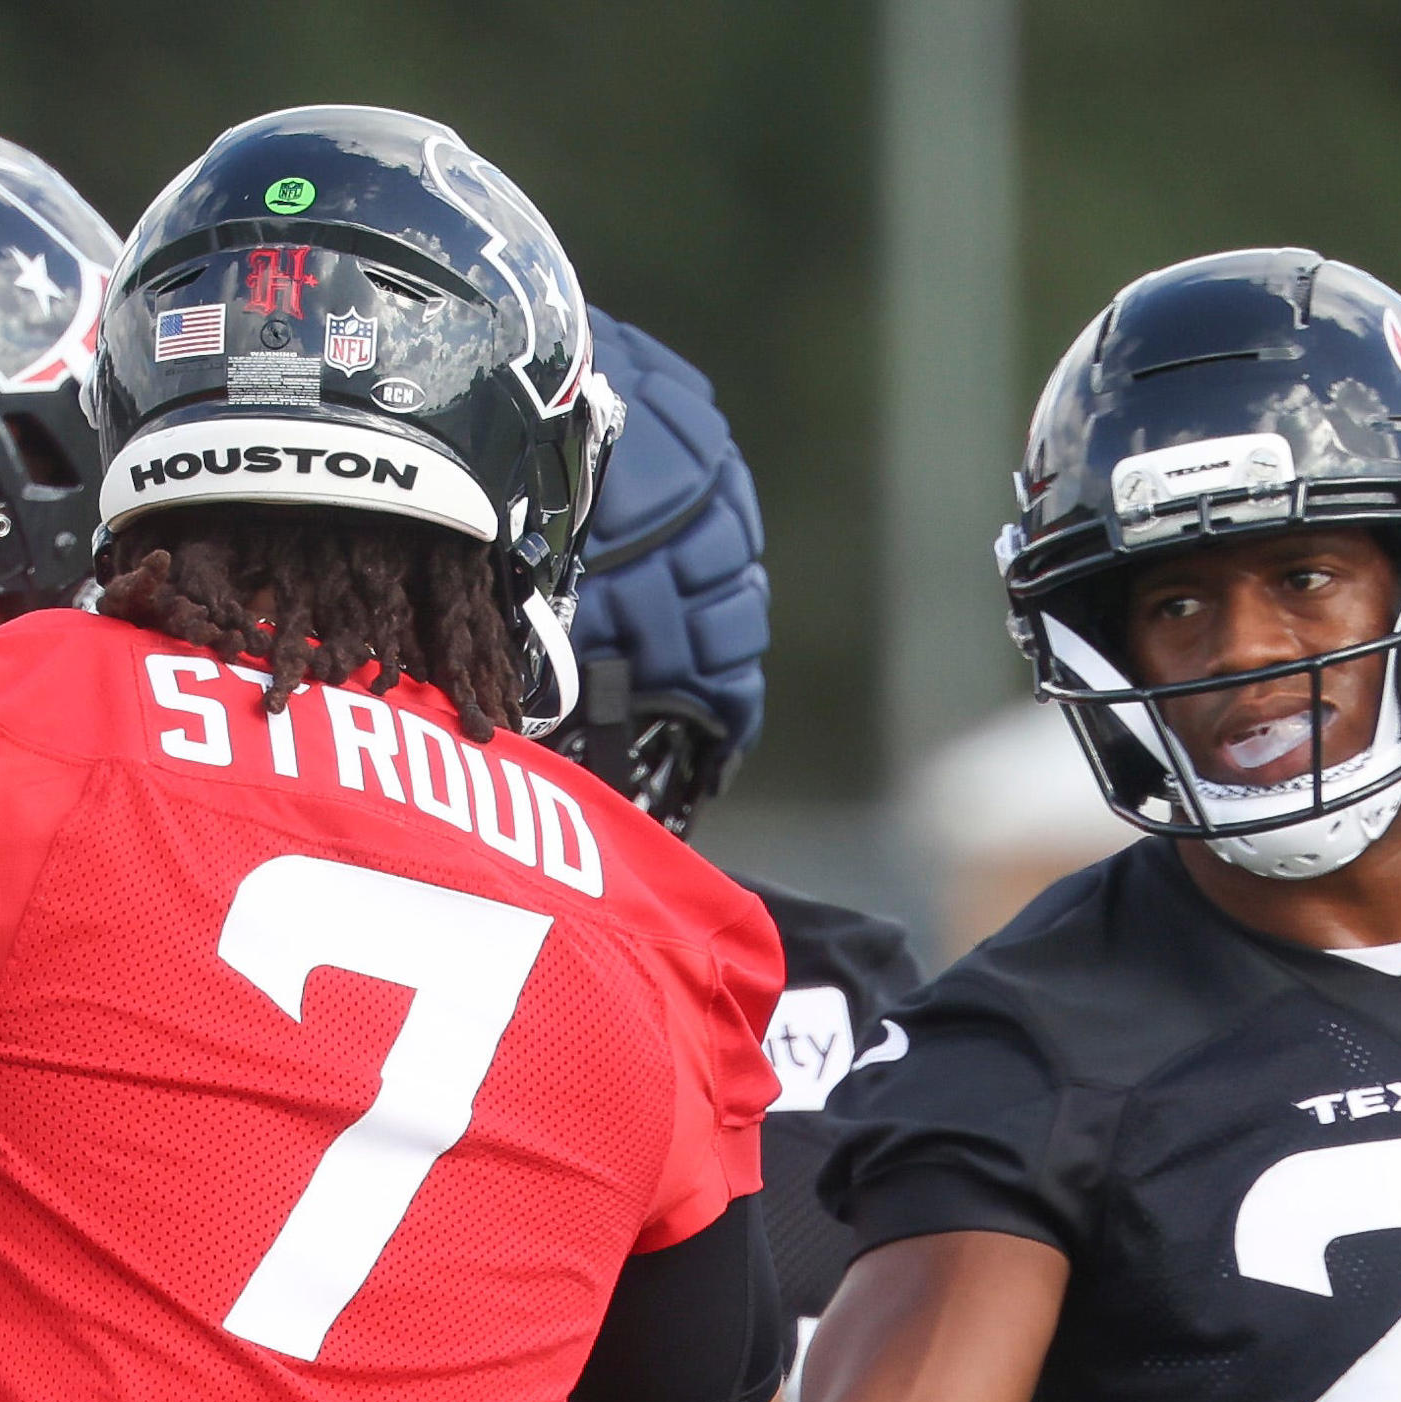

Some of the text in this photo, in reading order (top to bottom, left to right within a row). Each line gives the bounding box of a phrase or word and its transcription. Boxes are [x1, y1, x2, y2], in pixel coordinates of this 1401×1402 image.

[331, 337, 369, 365] NFL
[382, 386, 415, 404] RCM
[130, 446, 419, 492] HOUSTON
[144, 653, 605, 899] STROUD
[216, 853, 556, 1362] 7
